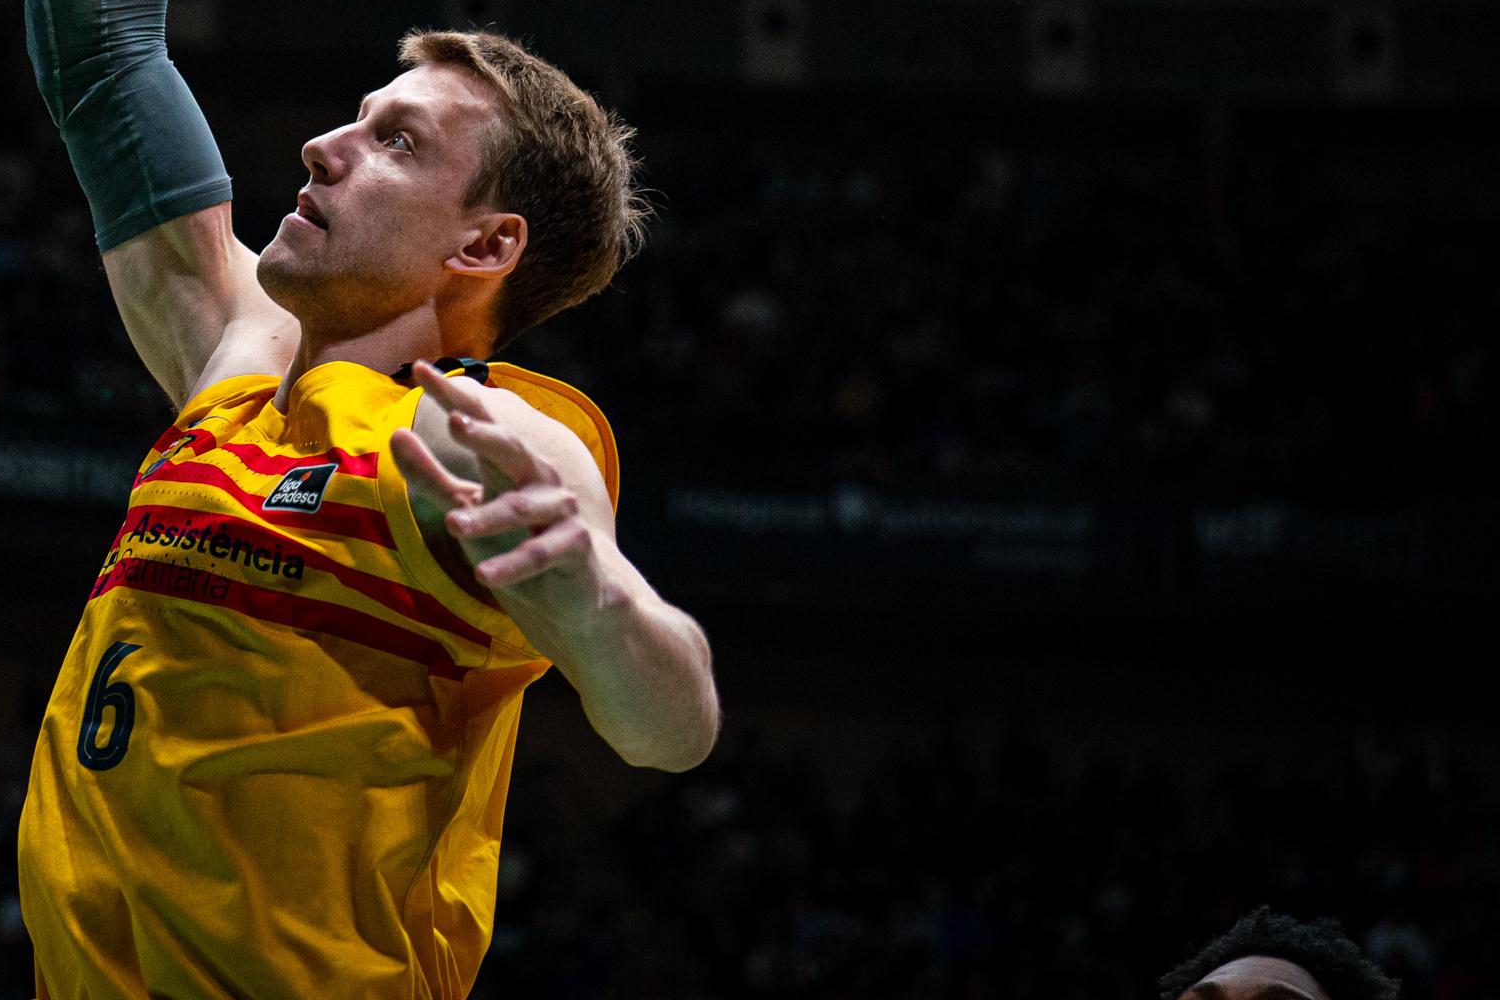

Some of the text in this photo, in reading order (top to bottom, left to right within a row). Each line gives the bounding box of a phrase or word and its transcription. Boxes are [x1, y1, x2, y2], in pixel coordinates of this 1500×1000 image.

[271, 488, 319, 505] endesa
[279, 477, 303, 492] liga
[128, 512, 305, 581] Assistència
[77, 641, 143, 771] 6
